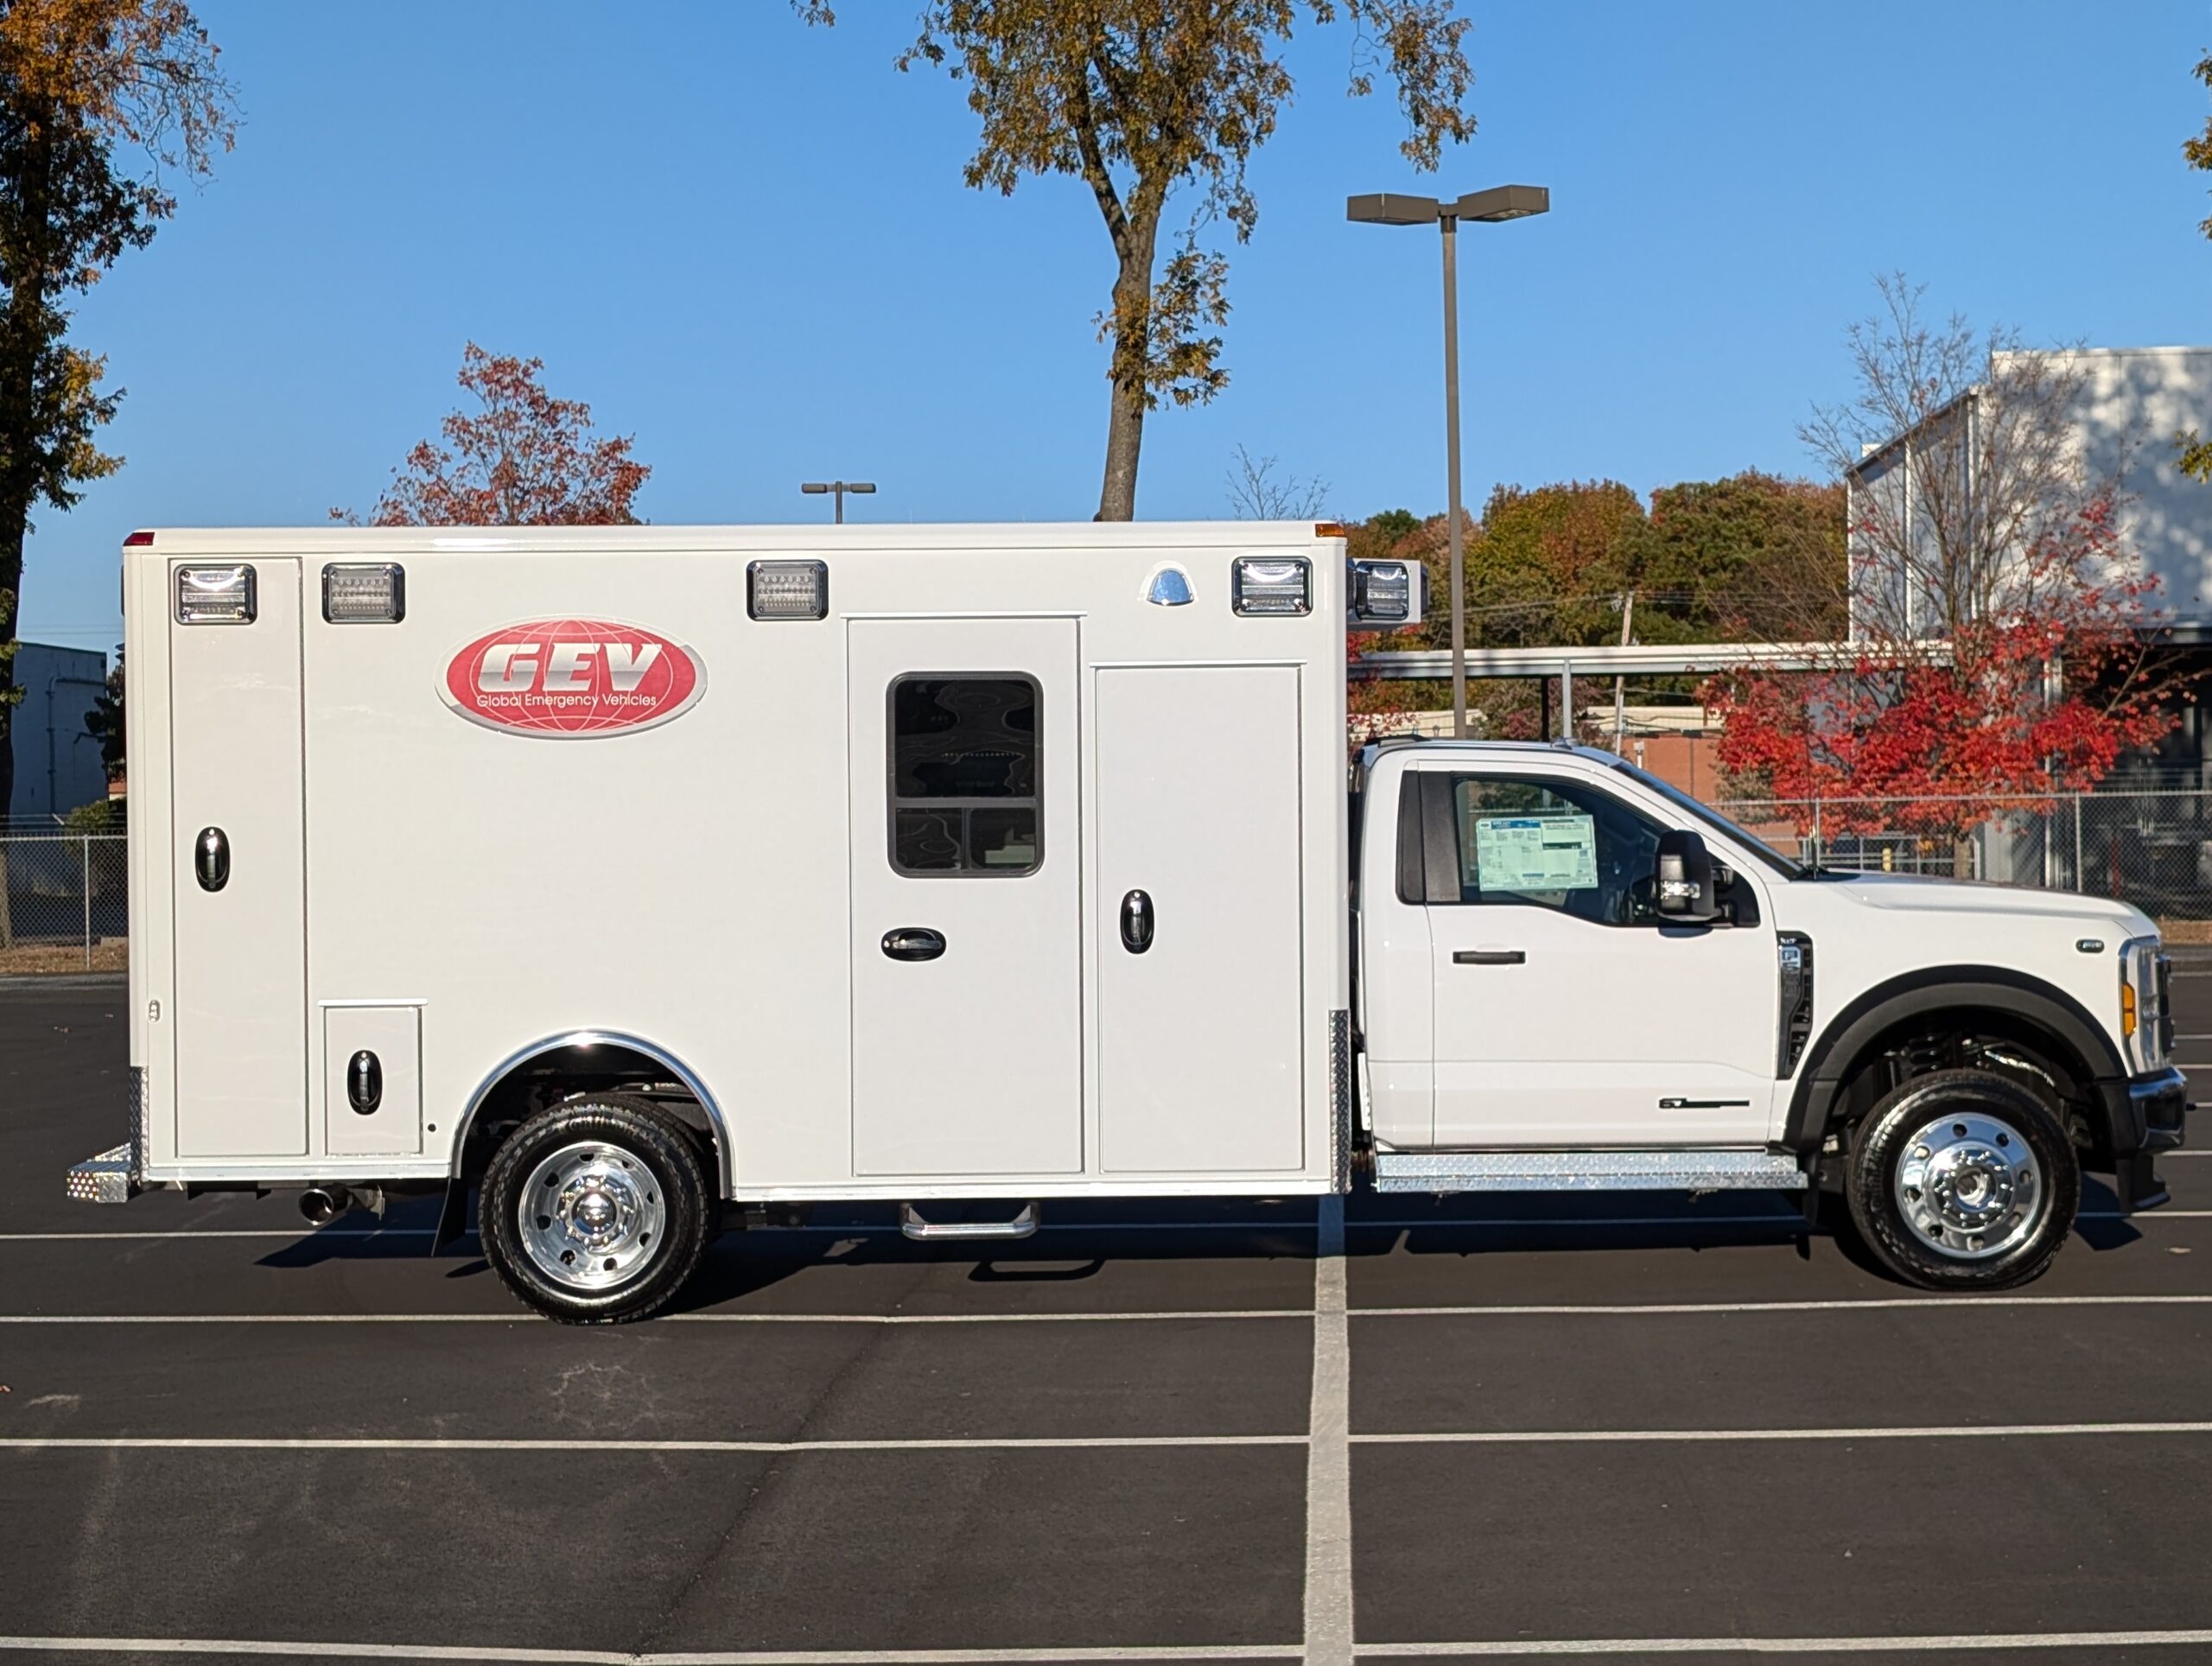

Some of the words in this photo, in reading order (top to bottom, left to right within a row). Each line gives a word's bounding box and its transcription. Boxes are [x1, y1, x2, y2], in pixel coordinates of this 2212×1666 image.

[478, 643, 663, 692] GEV
[477, 695, 521, 707] Global
[525, 695, 599, 708] Emergency
[602, 694, 657, 706] Vehicles
